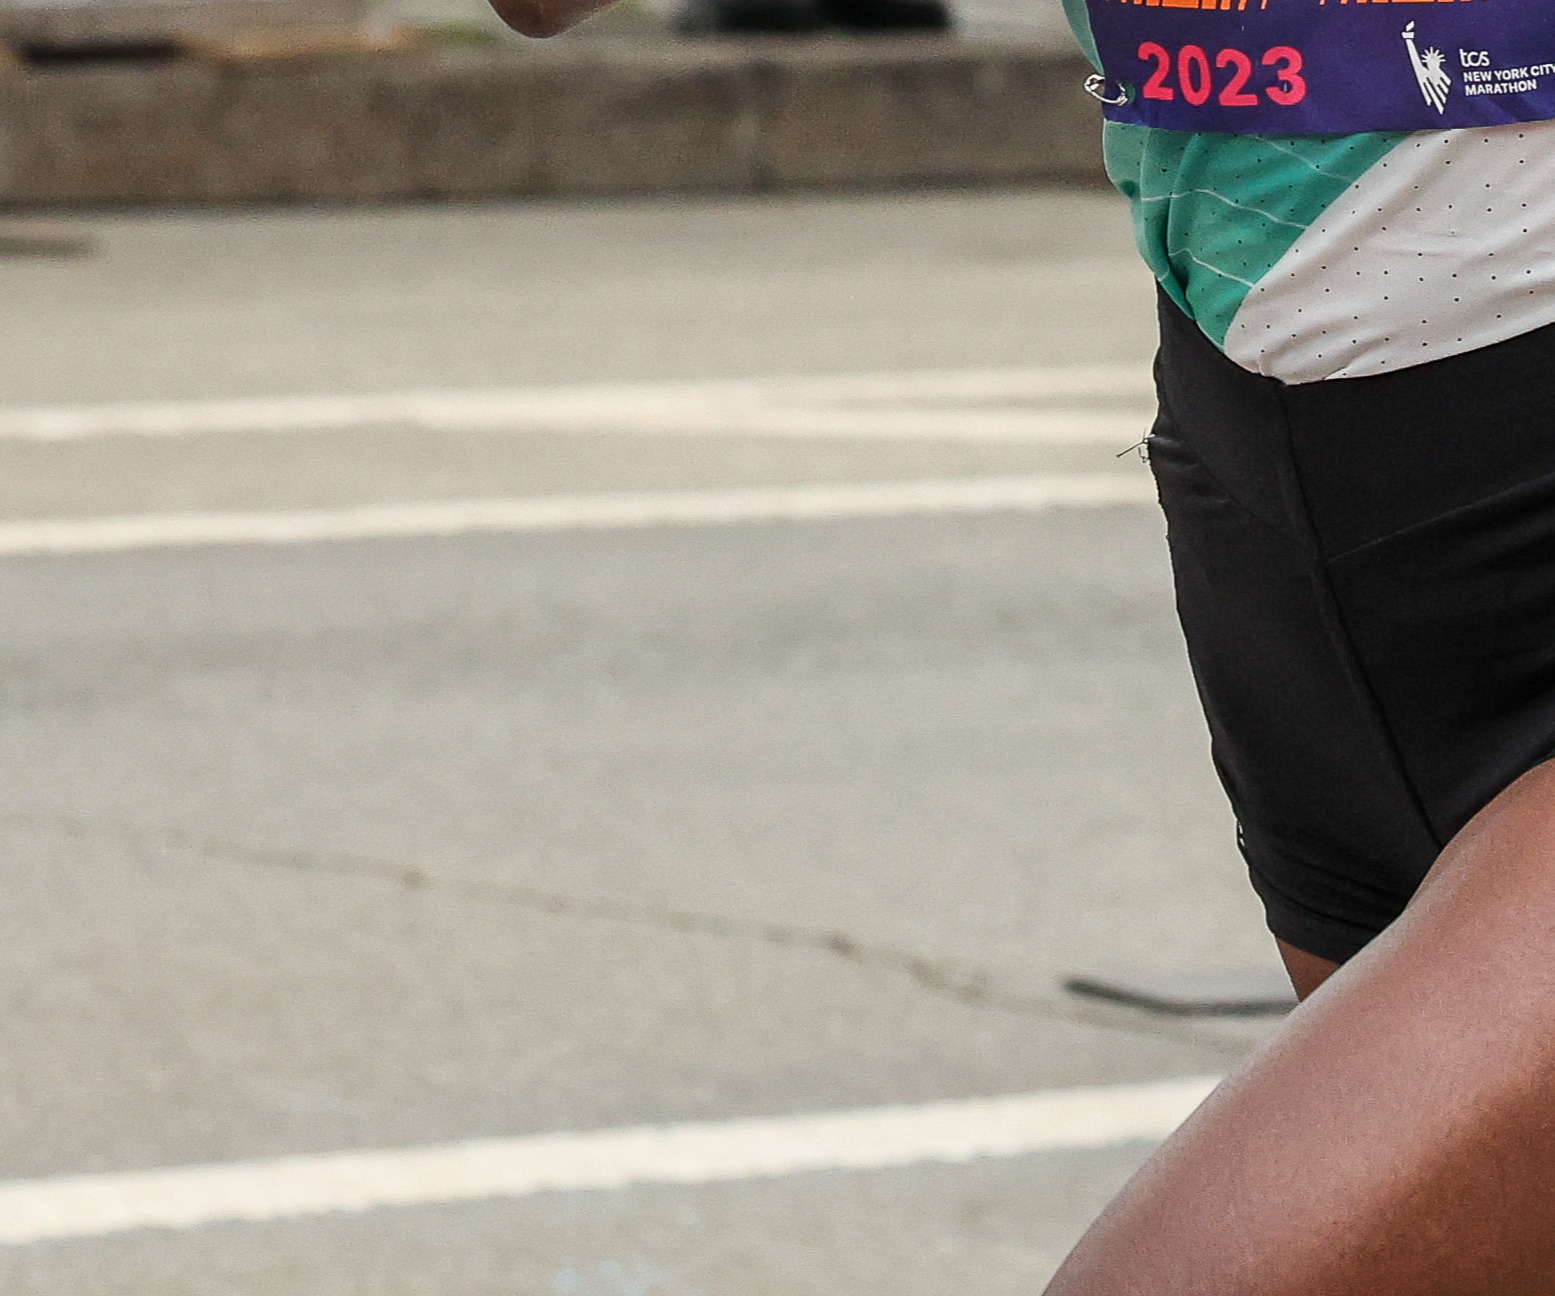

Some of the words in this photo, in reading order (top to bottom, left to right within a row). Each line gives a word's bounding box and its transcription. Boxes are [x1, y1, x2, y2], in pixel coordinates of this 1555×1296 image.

[1459, 48, 1491, 68] tcs
[1138, 41, 1307, 108] 2023
[1463, 70, 1492, 83] NEW
[1494, 67, 1529, 81] YORK
[1465, 79, 1538, 97] MARATHON
